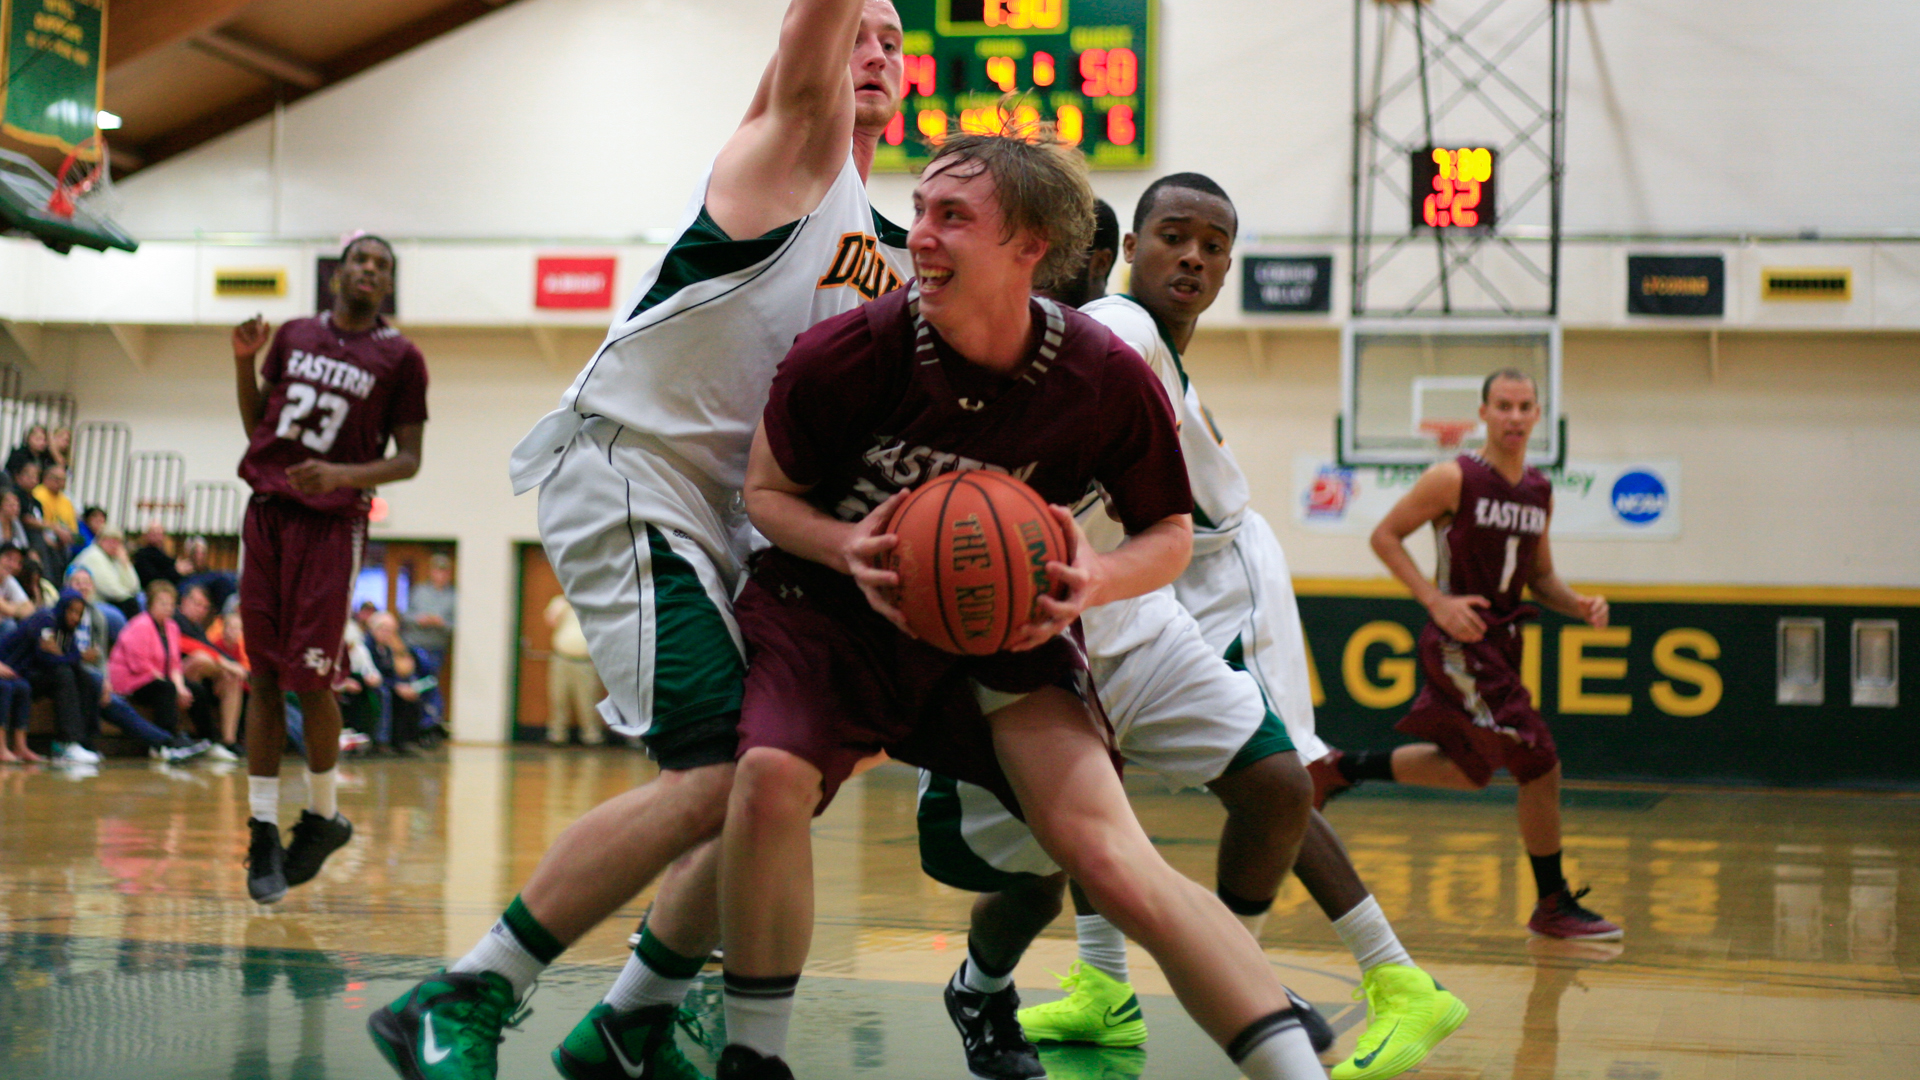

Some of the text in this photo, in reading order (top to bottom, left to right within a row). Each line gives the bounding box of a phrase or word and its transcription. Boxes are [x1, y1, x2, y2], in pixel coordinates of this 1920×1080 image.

[1079, 48, 1138, 97] 50
[287, 350, 376, 399] EASTERN
[275, 382, 350, 453] 23
[953, 513, 992, 572] THE
[1475, 497, 1547, 534] EASTERN
[1498, 535, 1521, 593] 1
[955, 582, 996, 640] ROCK
[1302, 620, 1724, 717] GIES
